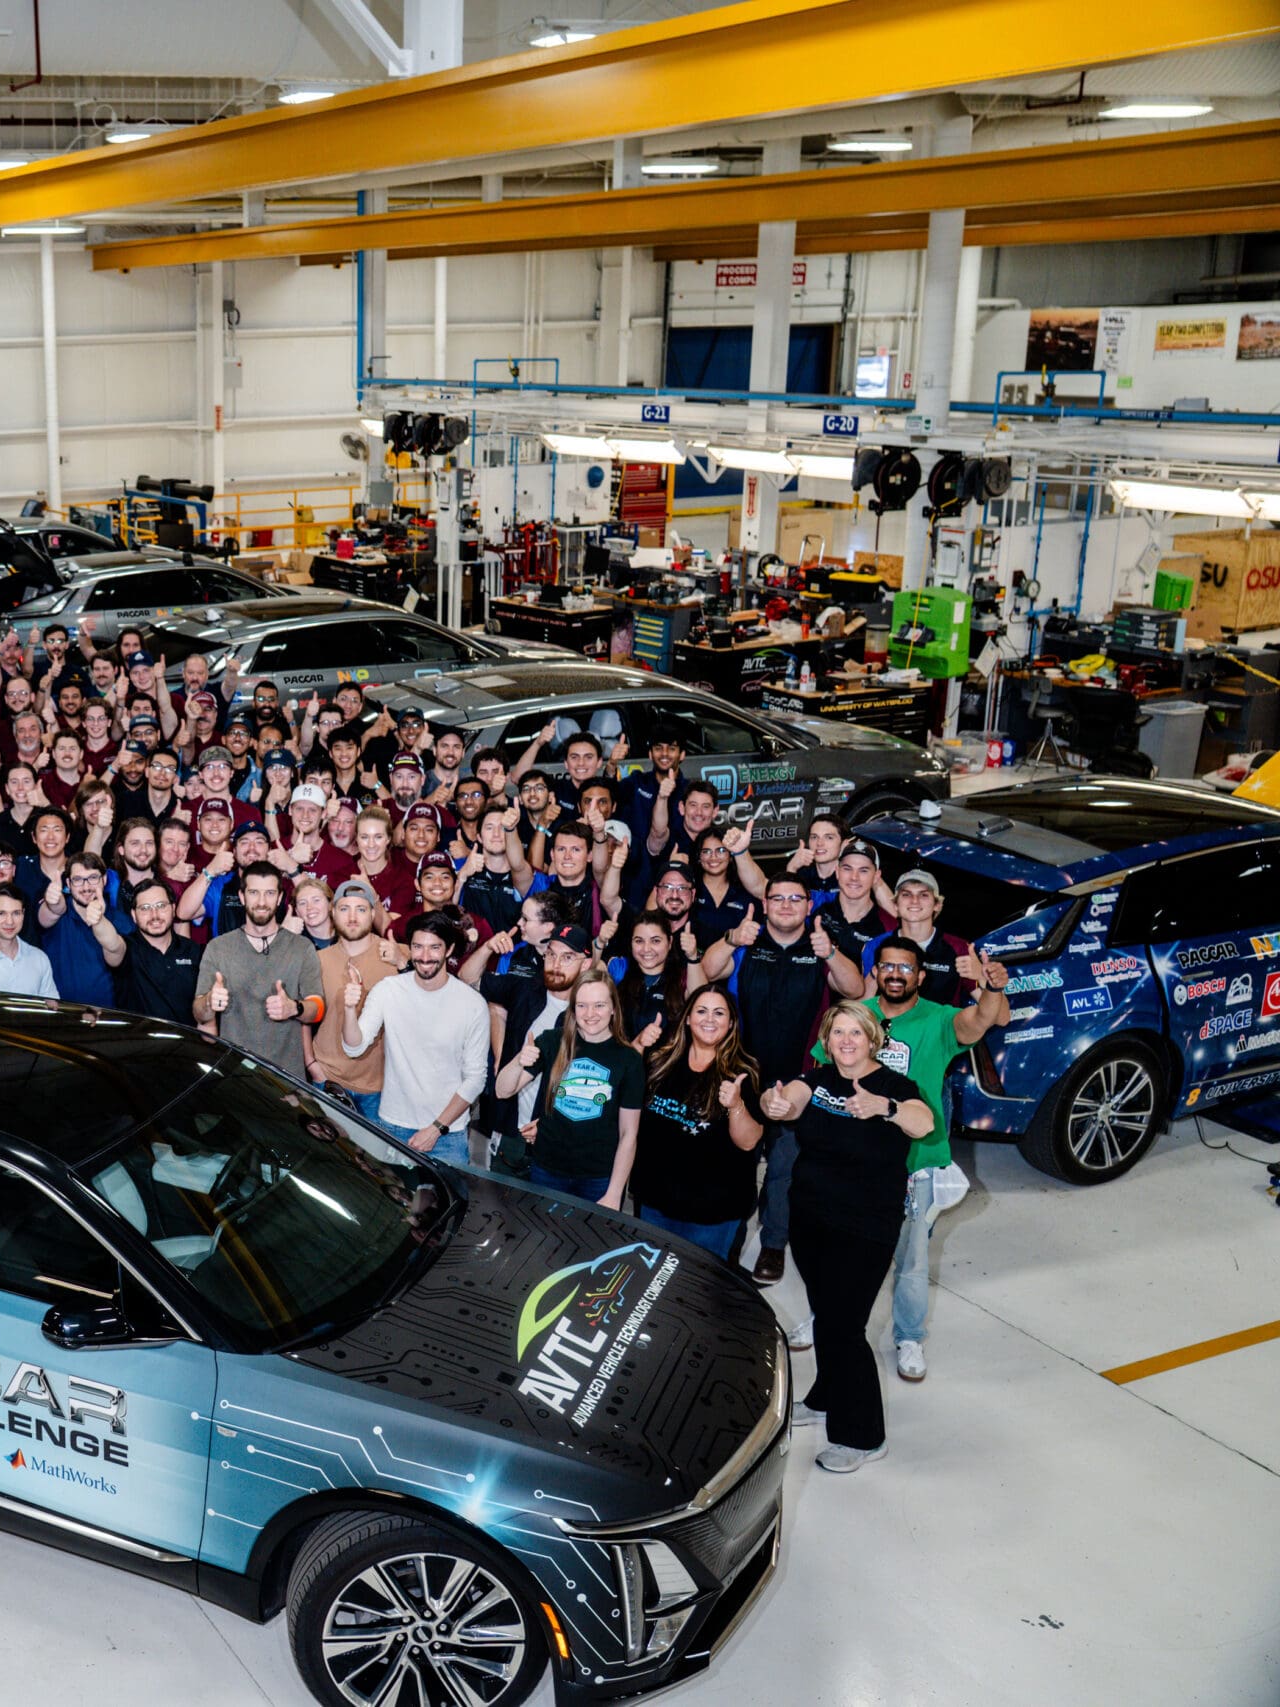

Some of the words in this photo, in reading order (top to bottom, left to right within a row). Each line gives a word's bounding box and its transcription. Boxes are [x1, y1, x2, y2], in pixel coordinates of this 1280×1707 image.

[794, 264, 806, 274] OR
[728, 276, 757, 285] COMPL
[643, 405, 667, 419] G-21
[826, 417, 855, 432] G-20
[1200, 561, 1228, 588] SU
[1246, 565, 1280, 591] OSU
[117, 609, 151, 619] PACCAR
[742, 657, 767, 670] AVTC
[283, 673, 325, 685] PACCAR
[337, 668, 370, 683] NXP
[739, 766, 797, 783] ENERGY
[755, 782, 813, 796] MathWorks
[712, 797, 805, 825] oCAR
[1177, 941, 1240, 969] PACCAR
[1250, 931, 1280, 961] NX
[1091, 955, 1137, 977] DENSO
[1004, 971, 1064, 995] EMENS
[1187, 977, 1227, 1000] BOSCH
[1072, 998, 1092, 1010] AVL
[1200, 1008, 1253, 1040] dSPACE
[814, 1086, 848, 1106] EcoC
[1186, 1088, 1201, 1106] 8
[571, 1378, 607, 1429] ADVANCED
[597, 1338, 627, 1380] VEHICLE
[615, 1299, 654, 1347] TECHNOLOGY
[643, 1253, 681, 1307] COMPETITIONS
[518, 1316, 609, 1415] AVTC
[31, 1456, 118, 1495] MathWorks
